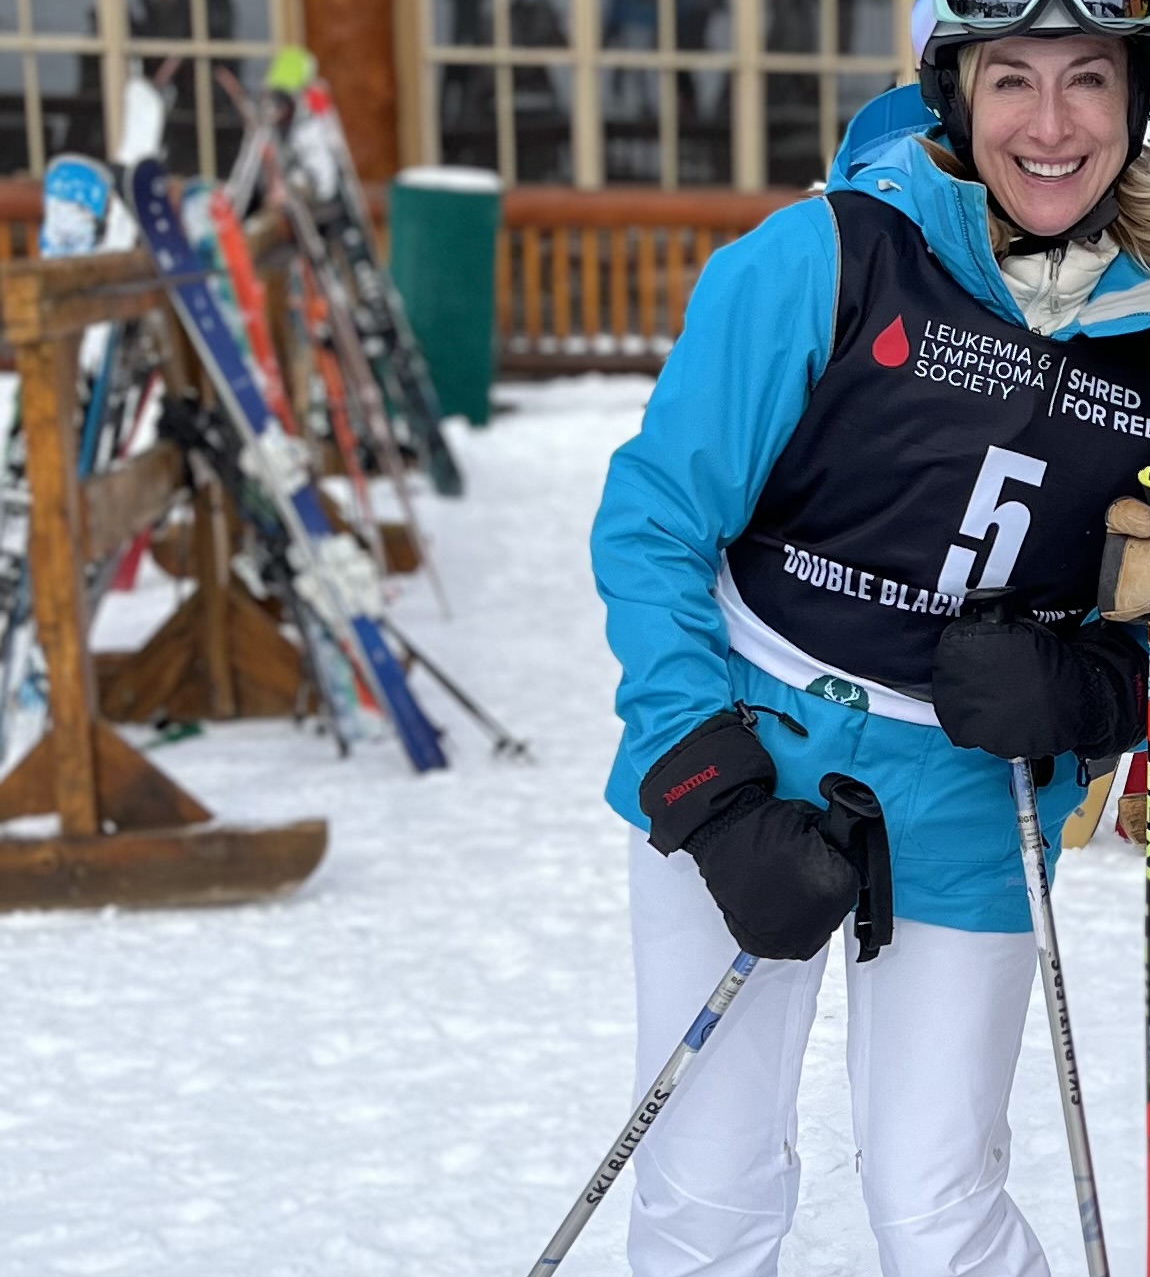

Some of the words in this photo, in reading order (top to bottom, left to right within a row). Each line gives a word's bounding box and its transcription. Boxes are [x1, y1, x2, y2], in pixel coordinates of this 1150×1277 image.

[918, 340, 1046, 391] LYMPHOMA
[924, 320, 1033, 366] LEUKEMIA
[1037, 353, 1052, 370] &
[914, 360, 1015, 401] SOCIETY
[1067, 368, 1142, 410] SHRED
[1061, 393, 1106, 427] FOR
[937, 445, 1048, 599] 5
[783, 544, 875, 601] DOUBLE
[879, 579, 965, 618] BLACK
[662, 764, 720, 807] Marmot
[586, 1173, 615, 1206] SKI
